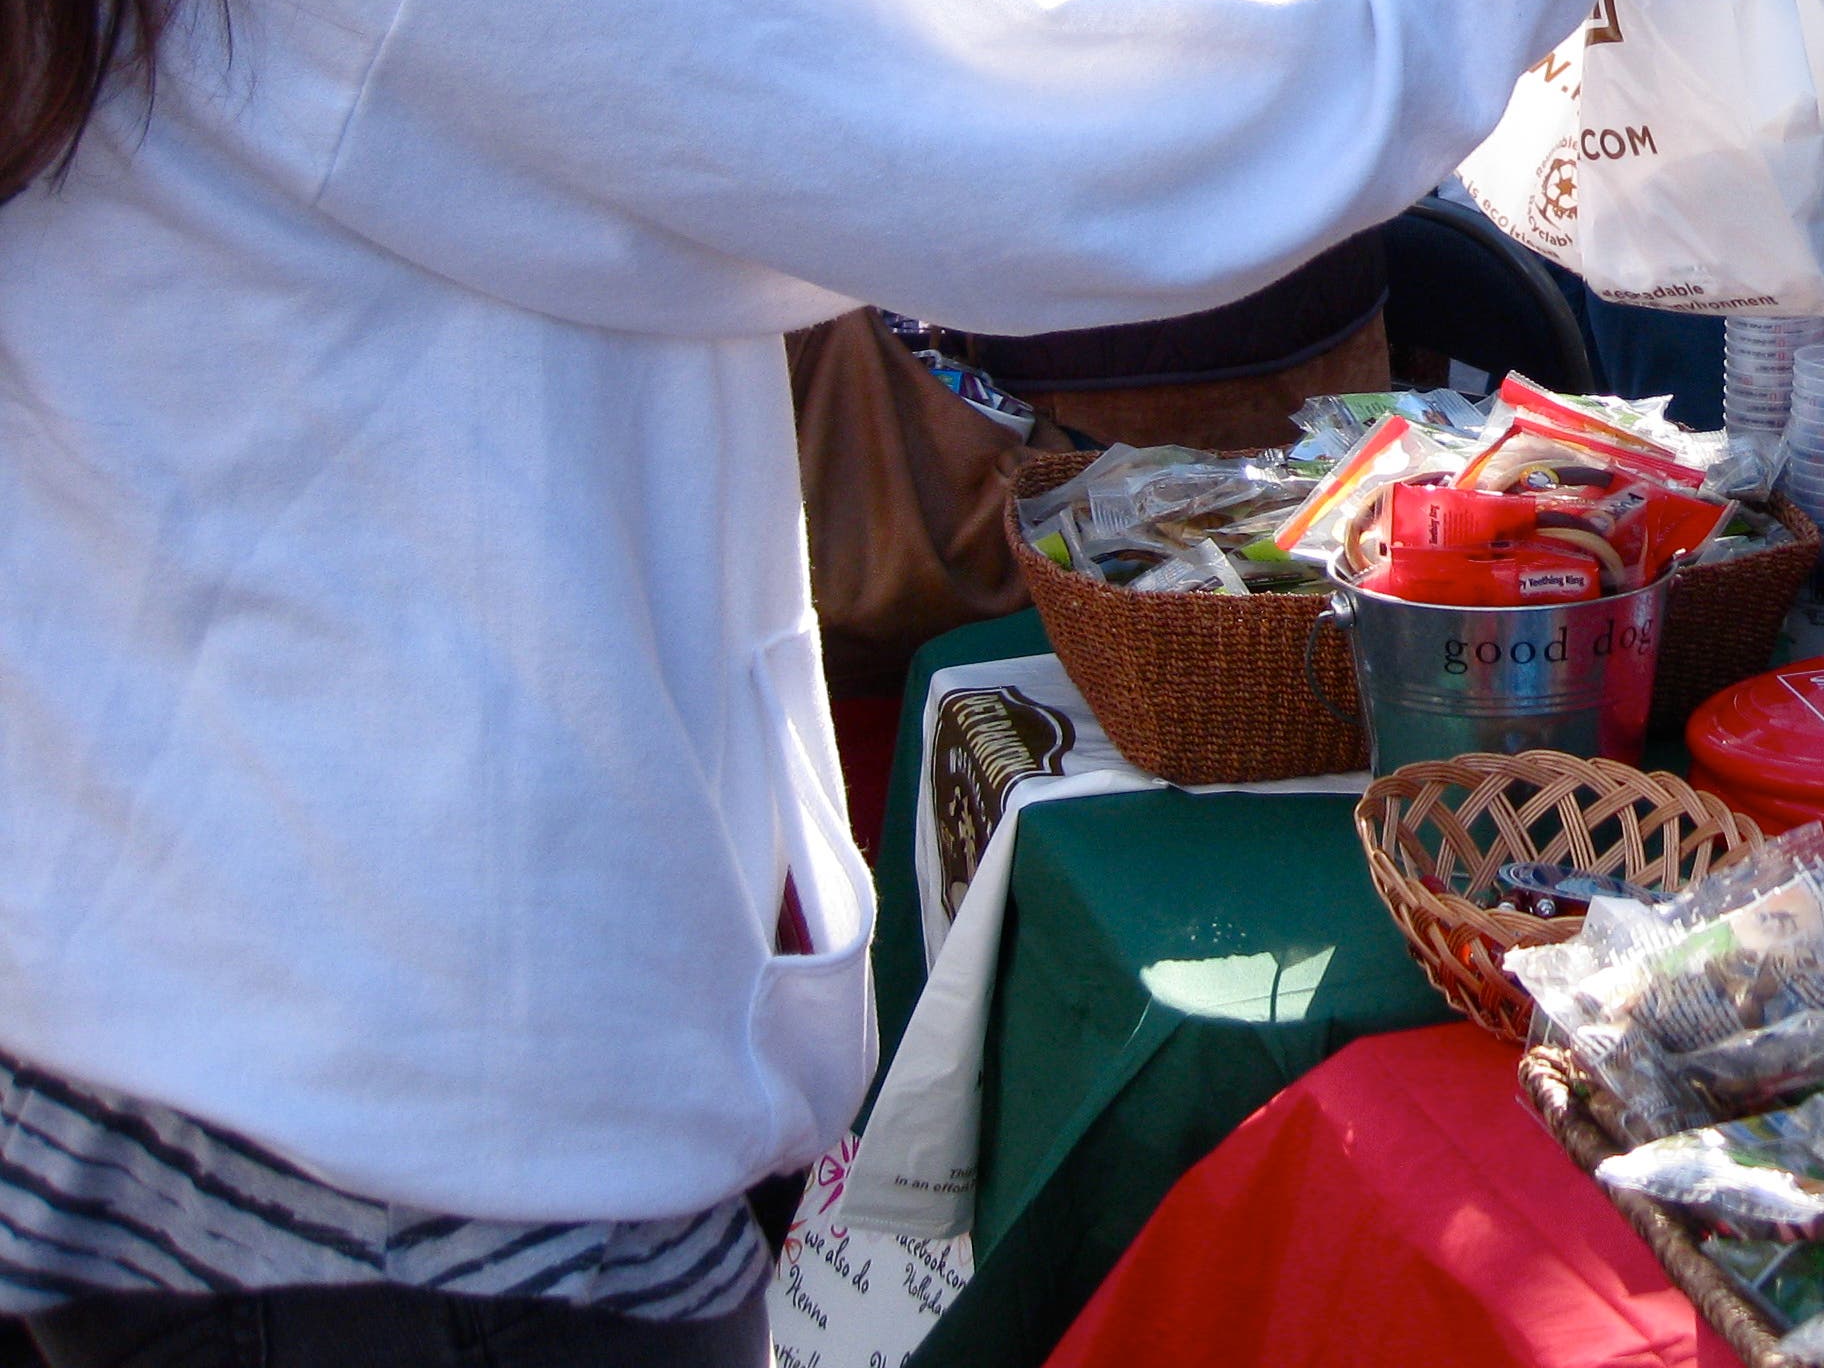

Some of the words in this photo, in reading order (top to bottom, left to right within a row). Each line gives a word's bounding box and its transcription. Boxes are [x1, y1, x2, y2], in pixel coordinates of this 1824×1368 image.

[1528, 574, 1564, 587] Teething
[1565, 575, 1586, 588] Ring
[1444, 626, 1568, 675] good
[1593, 618, 1654, 655] dog
[952, 694, 1009, 732] PET
[894, 1174, 909, 1186] in
[910, 1179, 930, 1191] an
[804, 1230, 825, 1255] we
[825, 1238, 850, 1278] also
[852, 1259, 872, 1295] do
[785, 1265, 828, 1330] Henna
